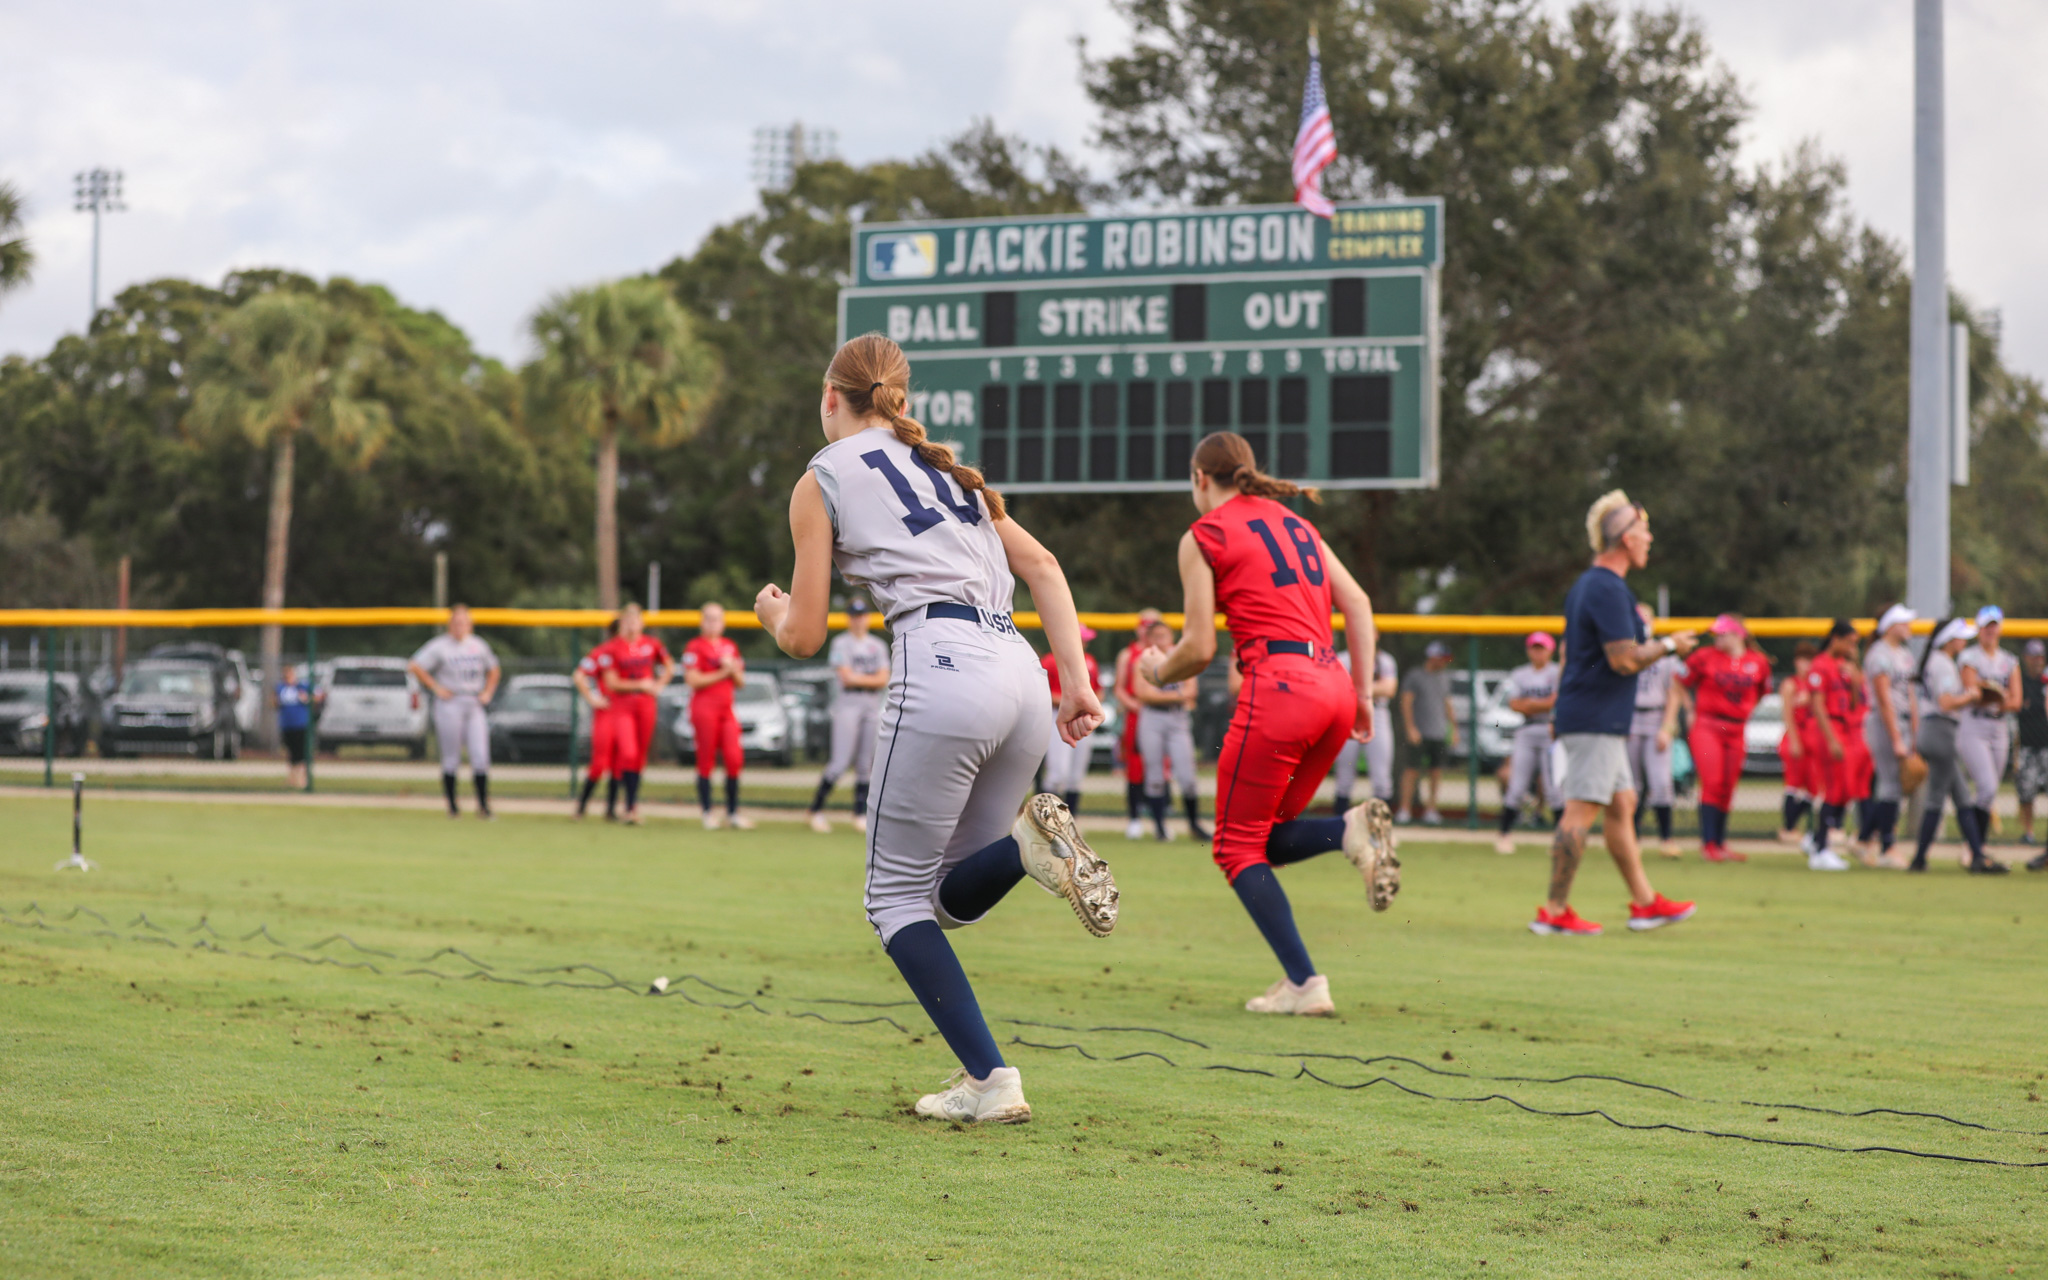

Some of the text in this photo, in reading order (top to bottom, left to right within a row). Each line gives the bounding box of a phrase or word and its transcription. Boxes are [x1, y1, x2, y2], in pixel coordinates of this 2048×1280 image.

[1331, 208, 1425, 233] TRAINING
[945, 214, 1315, 275] JACKIE ROBINSON
[1328, 234, 1424, 260] COMPLEX
[887, 290, 1326, 342] BALL STRIKE OUT
[988, 346, 1400, 381] 1 2 3 4 5 6 7 8 9 TOTAL
[910, 390, 975, 426] TOR
[1246, 516, 1325, 588] 18
[980, 608, 1016, 635] USA
